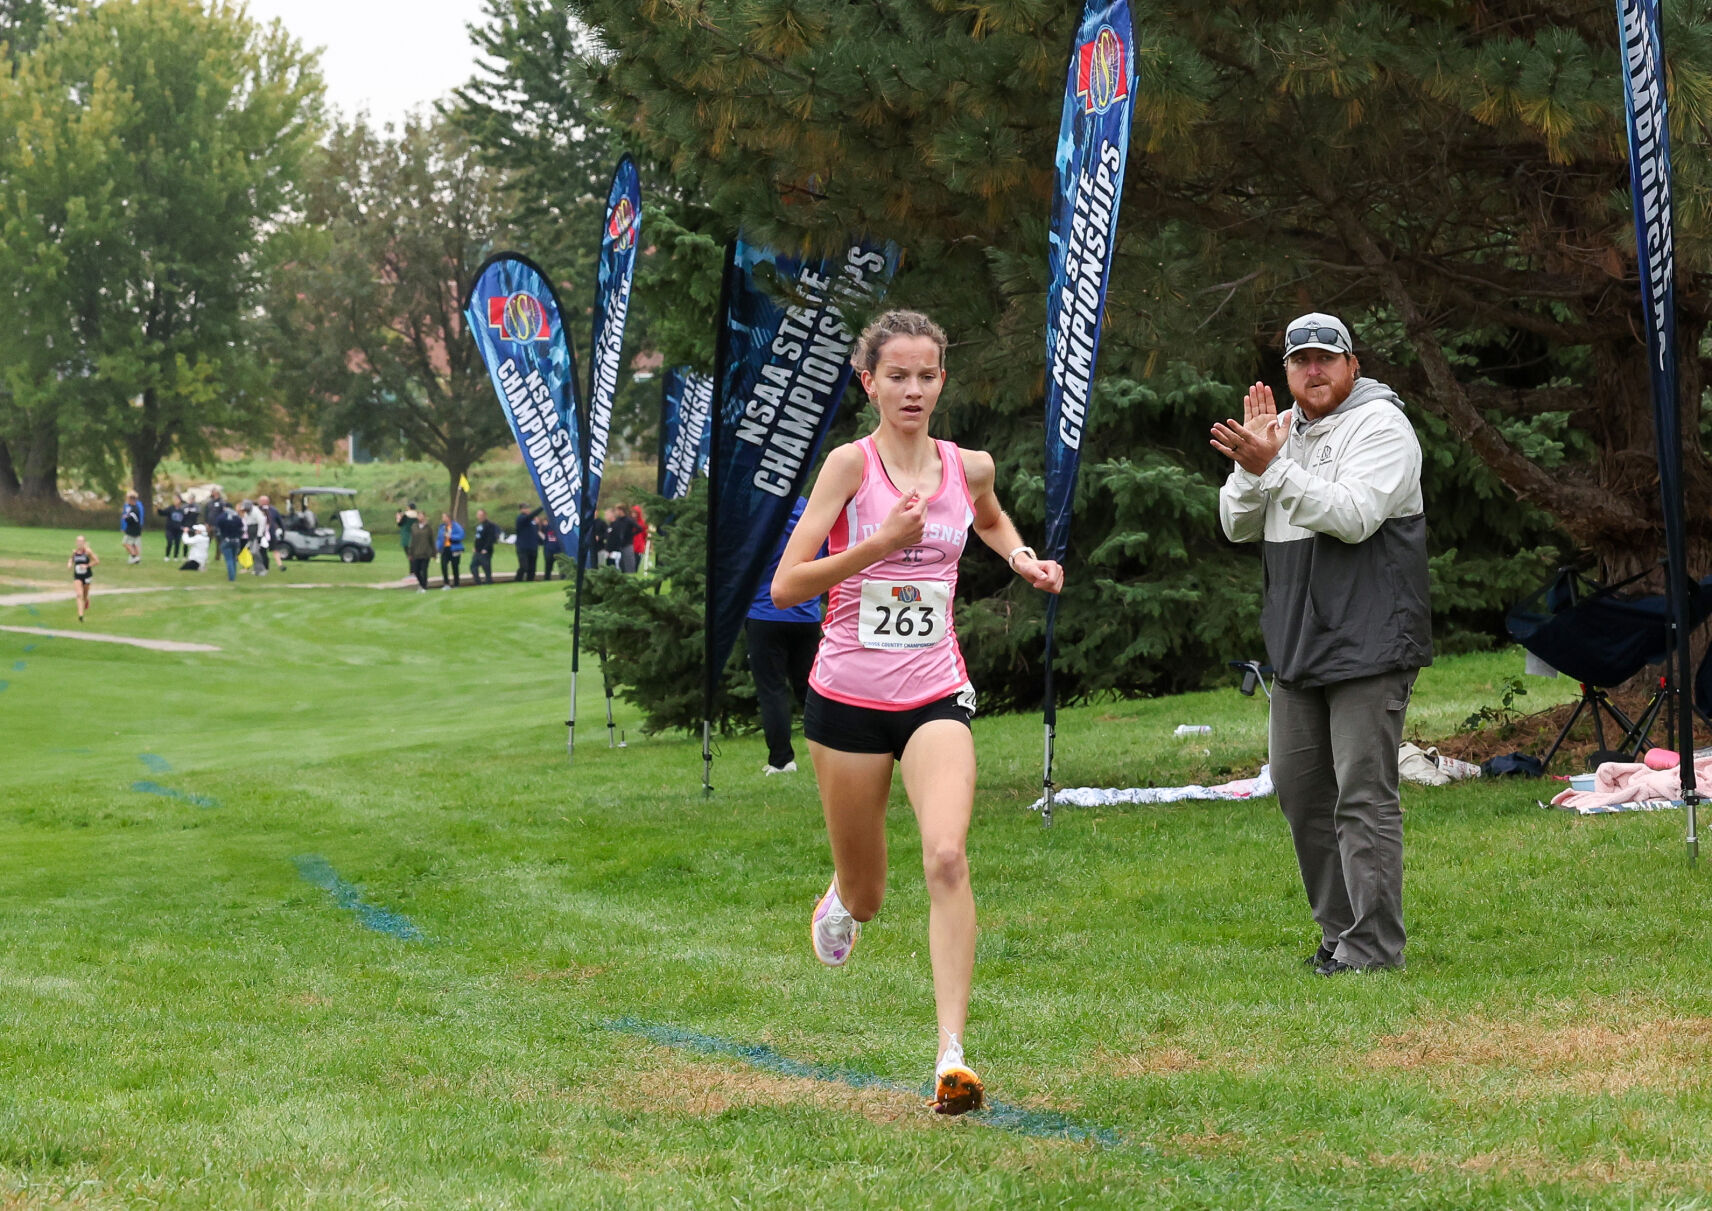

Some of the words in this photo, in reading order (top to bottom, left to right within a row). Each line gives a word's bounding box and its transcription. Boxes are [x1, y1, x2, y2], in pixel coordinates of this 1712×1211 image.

[1052, 285, 1075, 388] NSAA
[1066, 167, 1095, 279] STATE
[1058, 138, 1121, 452] CHAMPIONSHIPS
[496, 357, 581, 536] CHAMPIONSHIPS
[524, 369, 560, 432] NSAA
[551, 428, 582, 496] STATE
[666, 424, 686, 477] NSAA
[735, 363, 793, 447] NSAA
[902, 549, 924, 563] XC
[873, 605, 934, 637] 263
